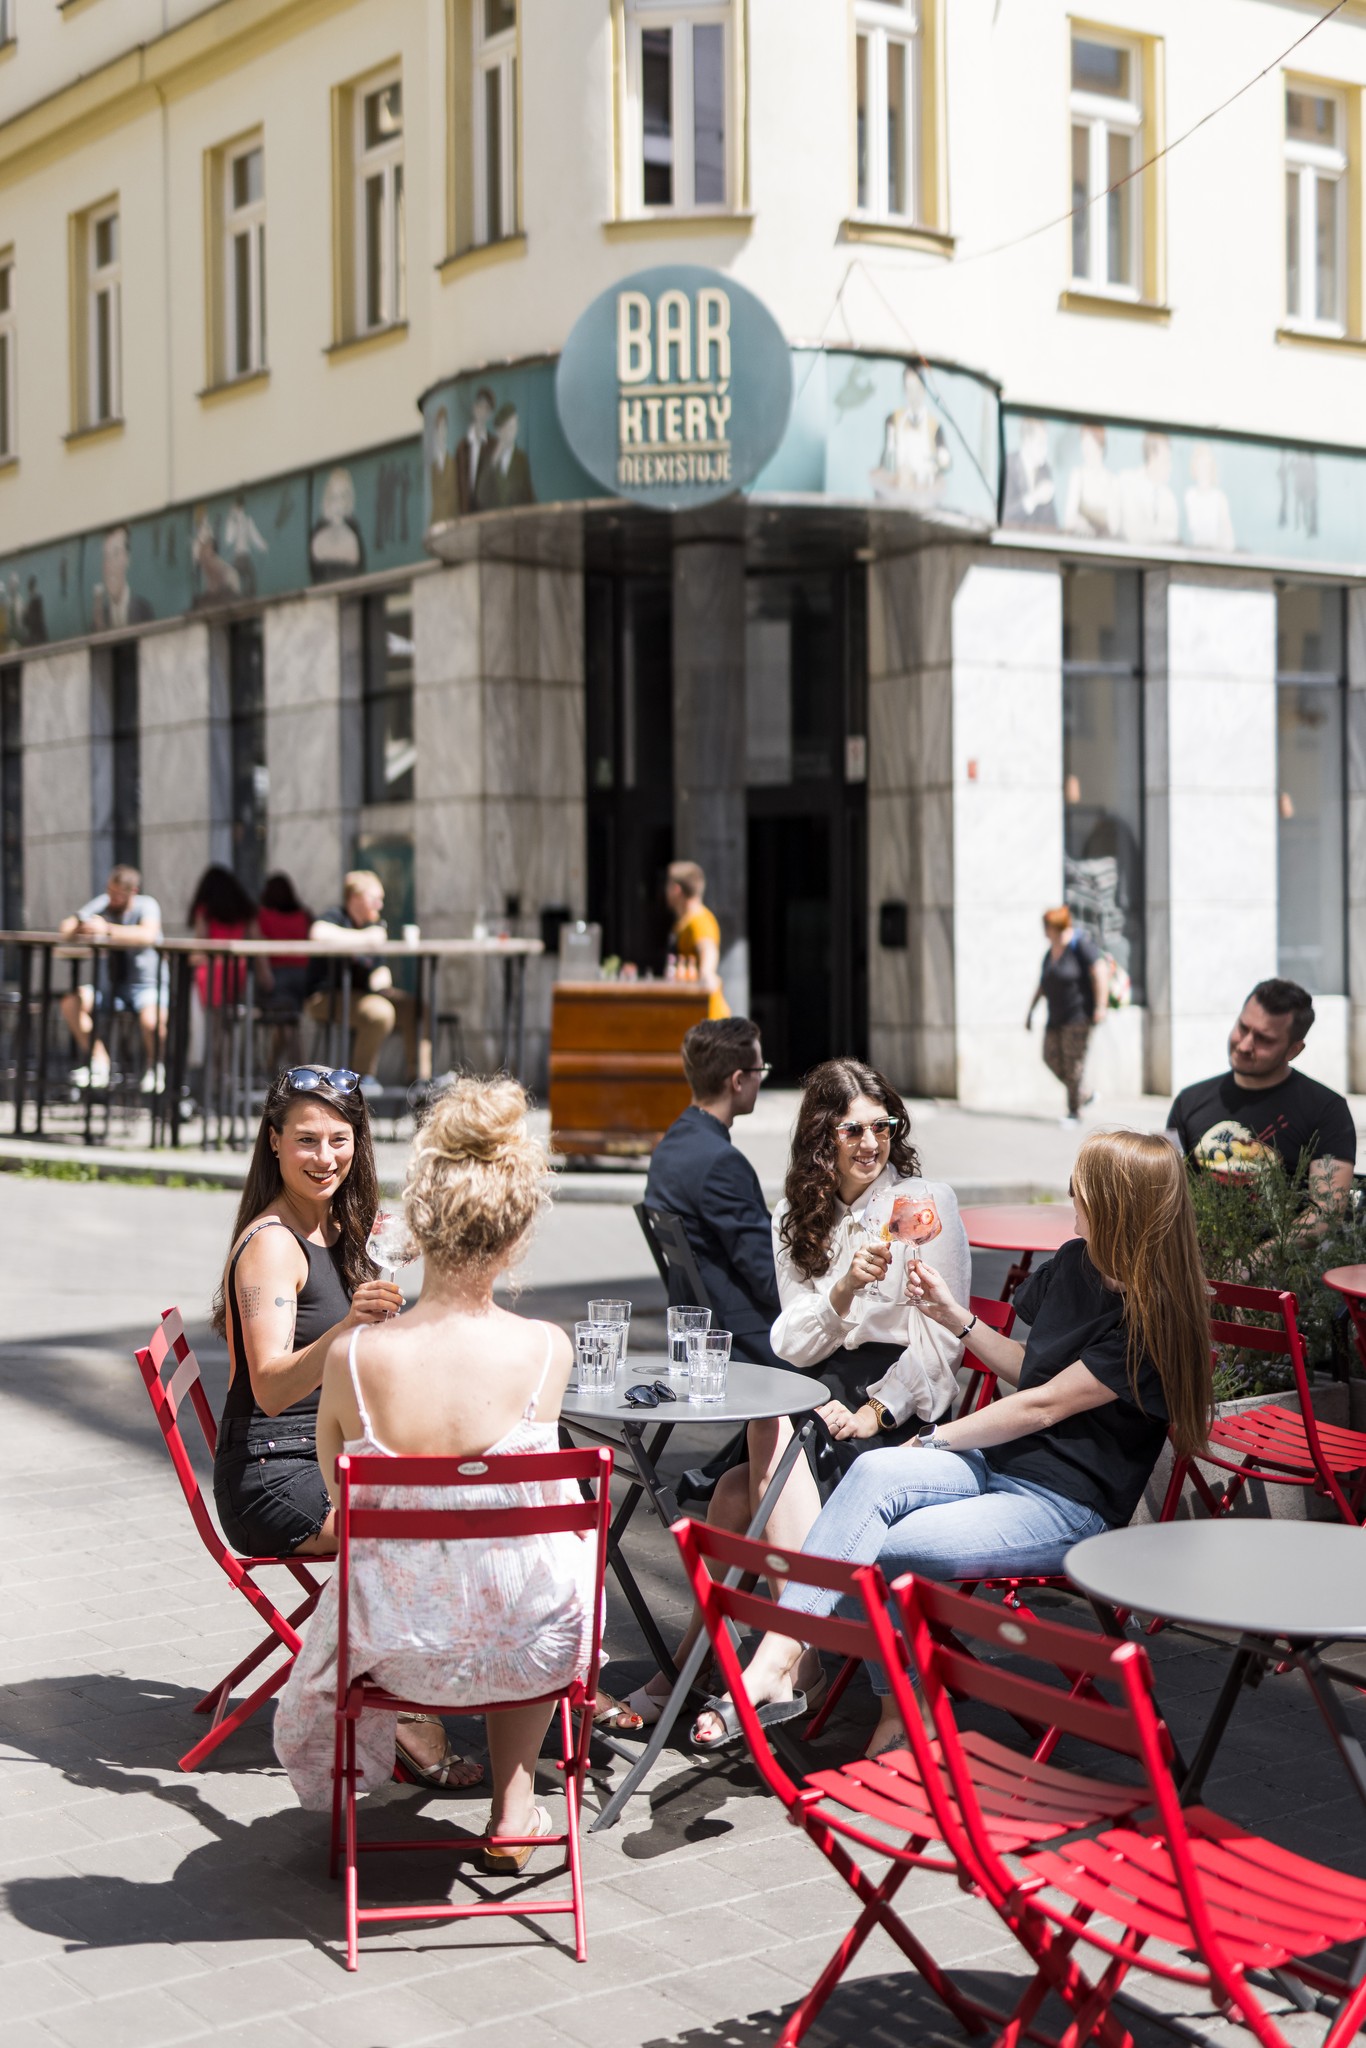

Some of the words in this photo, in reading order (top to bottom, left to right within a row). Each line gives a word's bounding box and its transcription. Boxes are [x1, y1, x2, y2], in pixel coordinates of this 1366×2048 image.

[618, 288, 731, 382] BAR
[620, 382, 731, 443] KTERÝ
[619, 454, 731, 484] NEEXISTUJE
